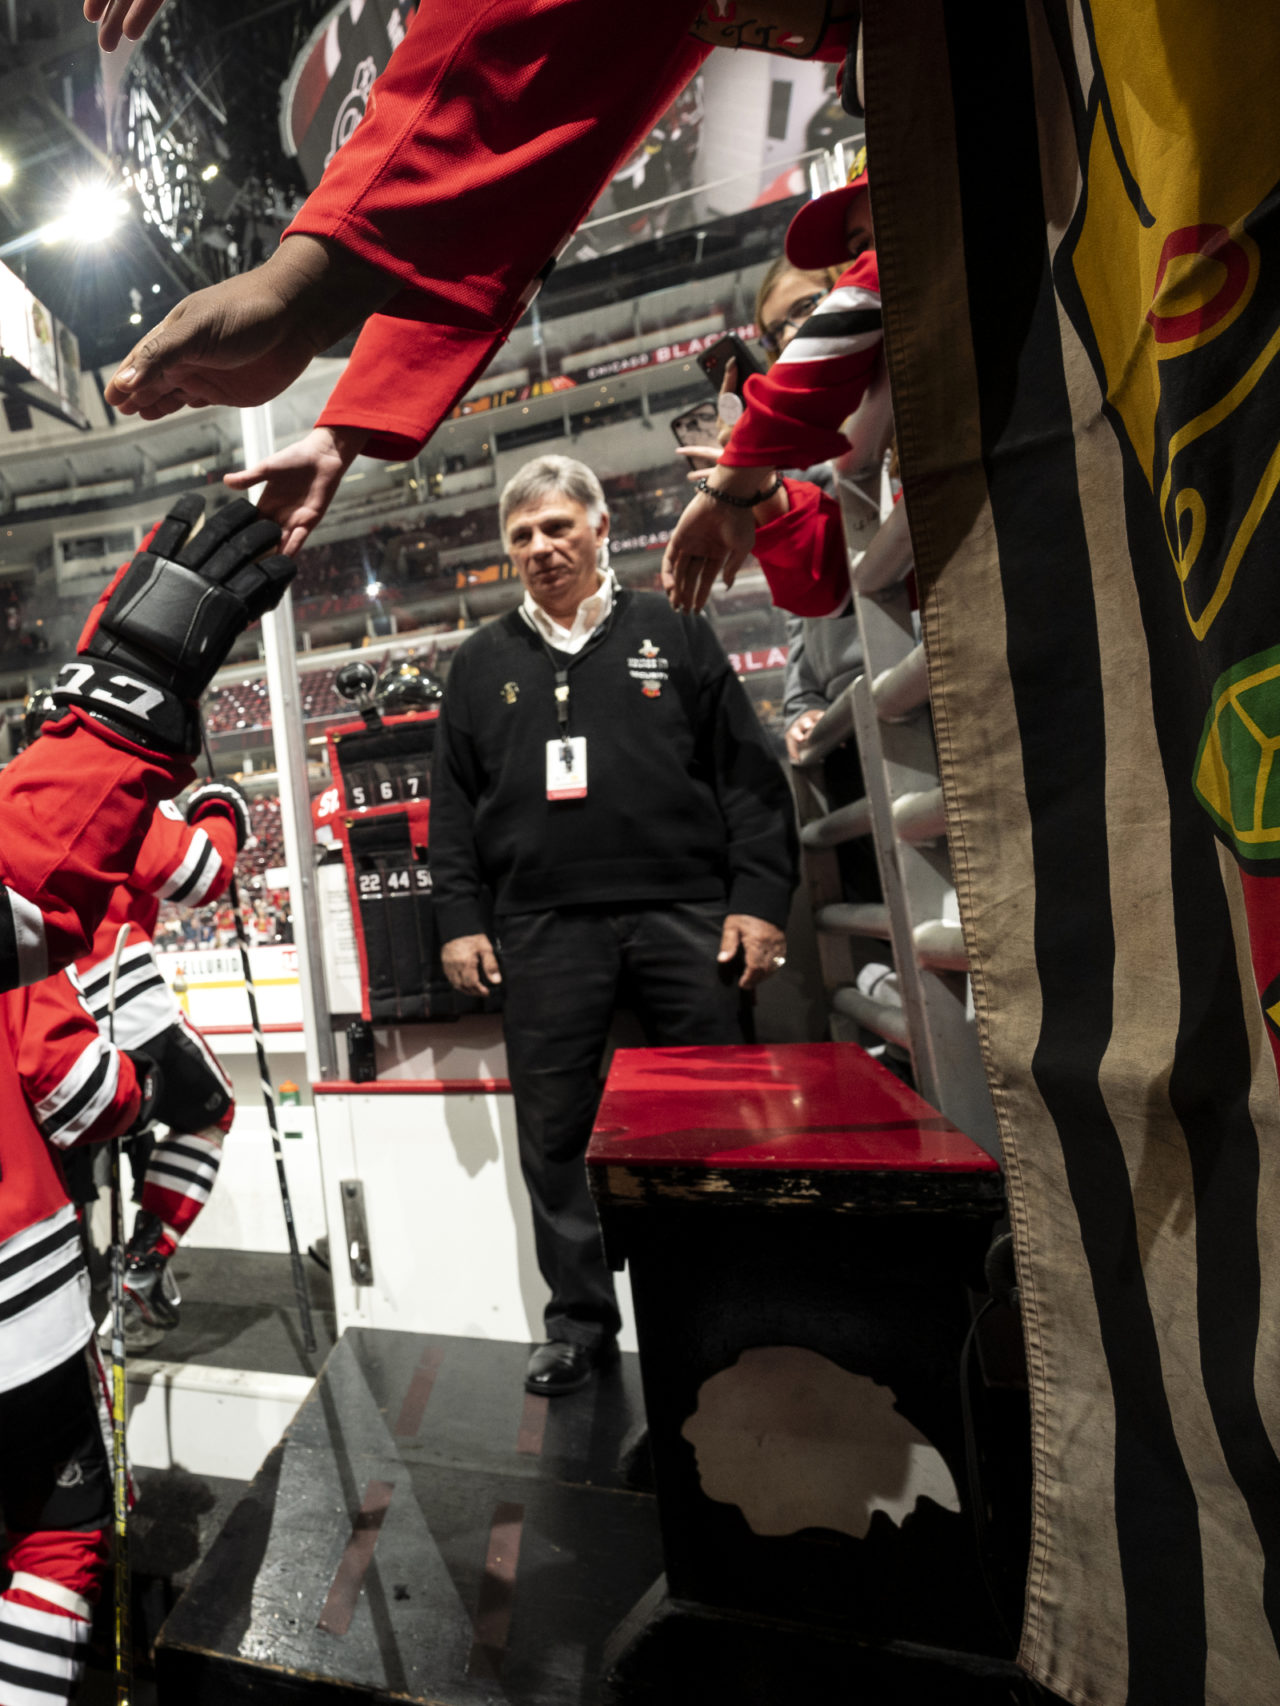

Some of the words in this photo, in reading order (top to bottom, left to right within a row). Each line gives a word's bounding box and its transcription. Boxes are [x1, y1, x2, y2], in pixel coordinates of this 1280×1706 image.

[587, 352, 650, 380] CHICAGO
[352, 786, 366, 805] 5
[379, 781, 394, 800] 6
[406, 776, 419, 796] 7
[358, 873, 382, 892] 22
[387, 870, 411, 890] 44
